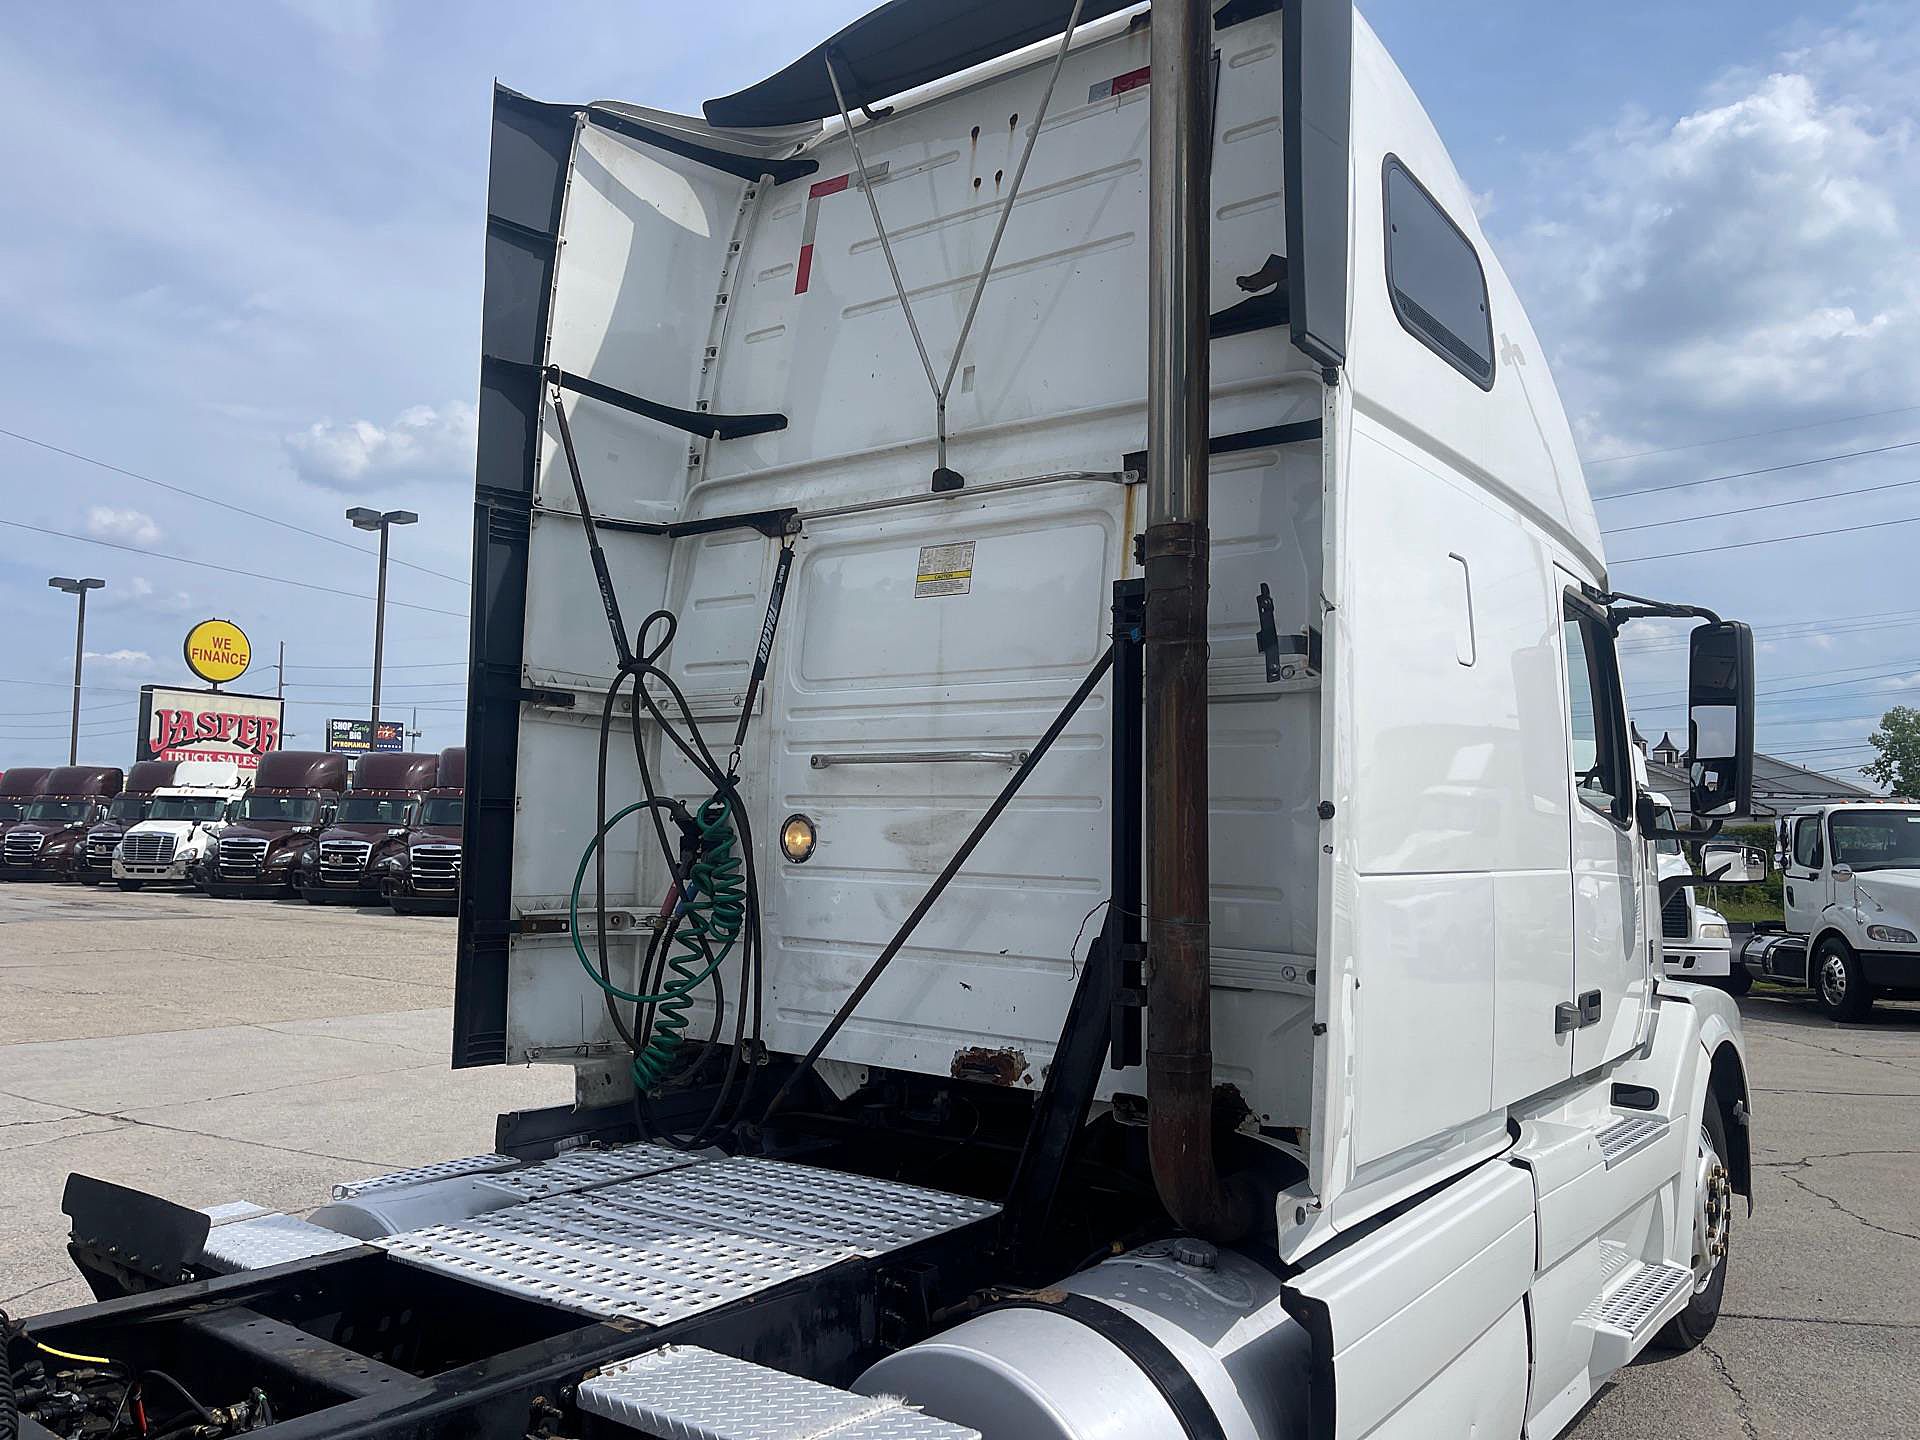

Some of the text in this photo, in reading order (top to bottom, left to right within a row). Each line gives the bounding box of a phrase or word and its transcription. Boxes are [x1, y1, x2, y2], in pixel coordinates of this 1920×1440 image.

[758, 603, 778, 664] TRACKER
[212, 636, 231, 650] WE
[191, 647, 247, 666] FINANCE
[149, 708, 280, 755] JASPER
[333, 721, 353, 731] SHOP
[349, 731, 362, 740] BIG
[332, 741, 371, 749] PYROMANIAC
[165, 750, 260, 767] TRUCK SALES
